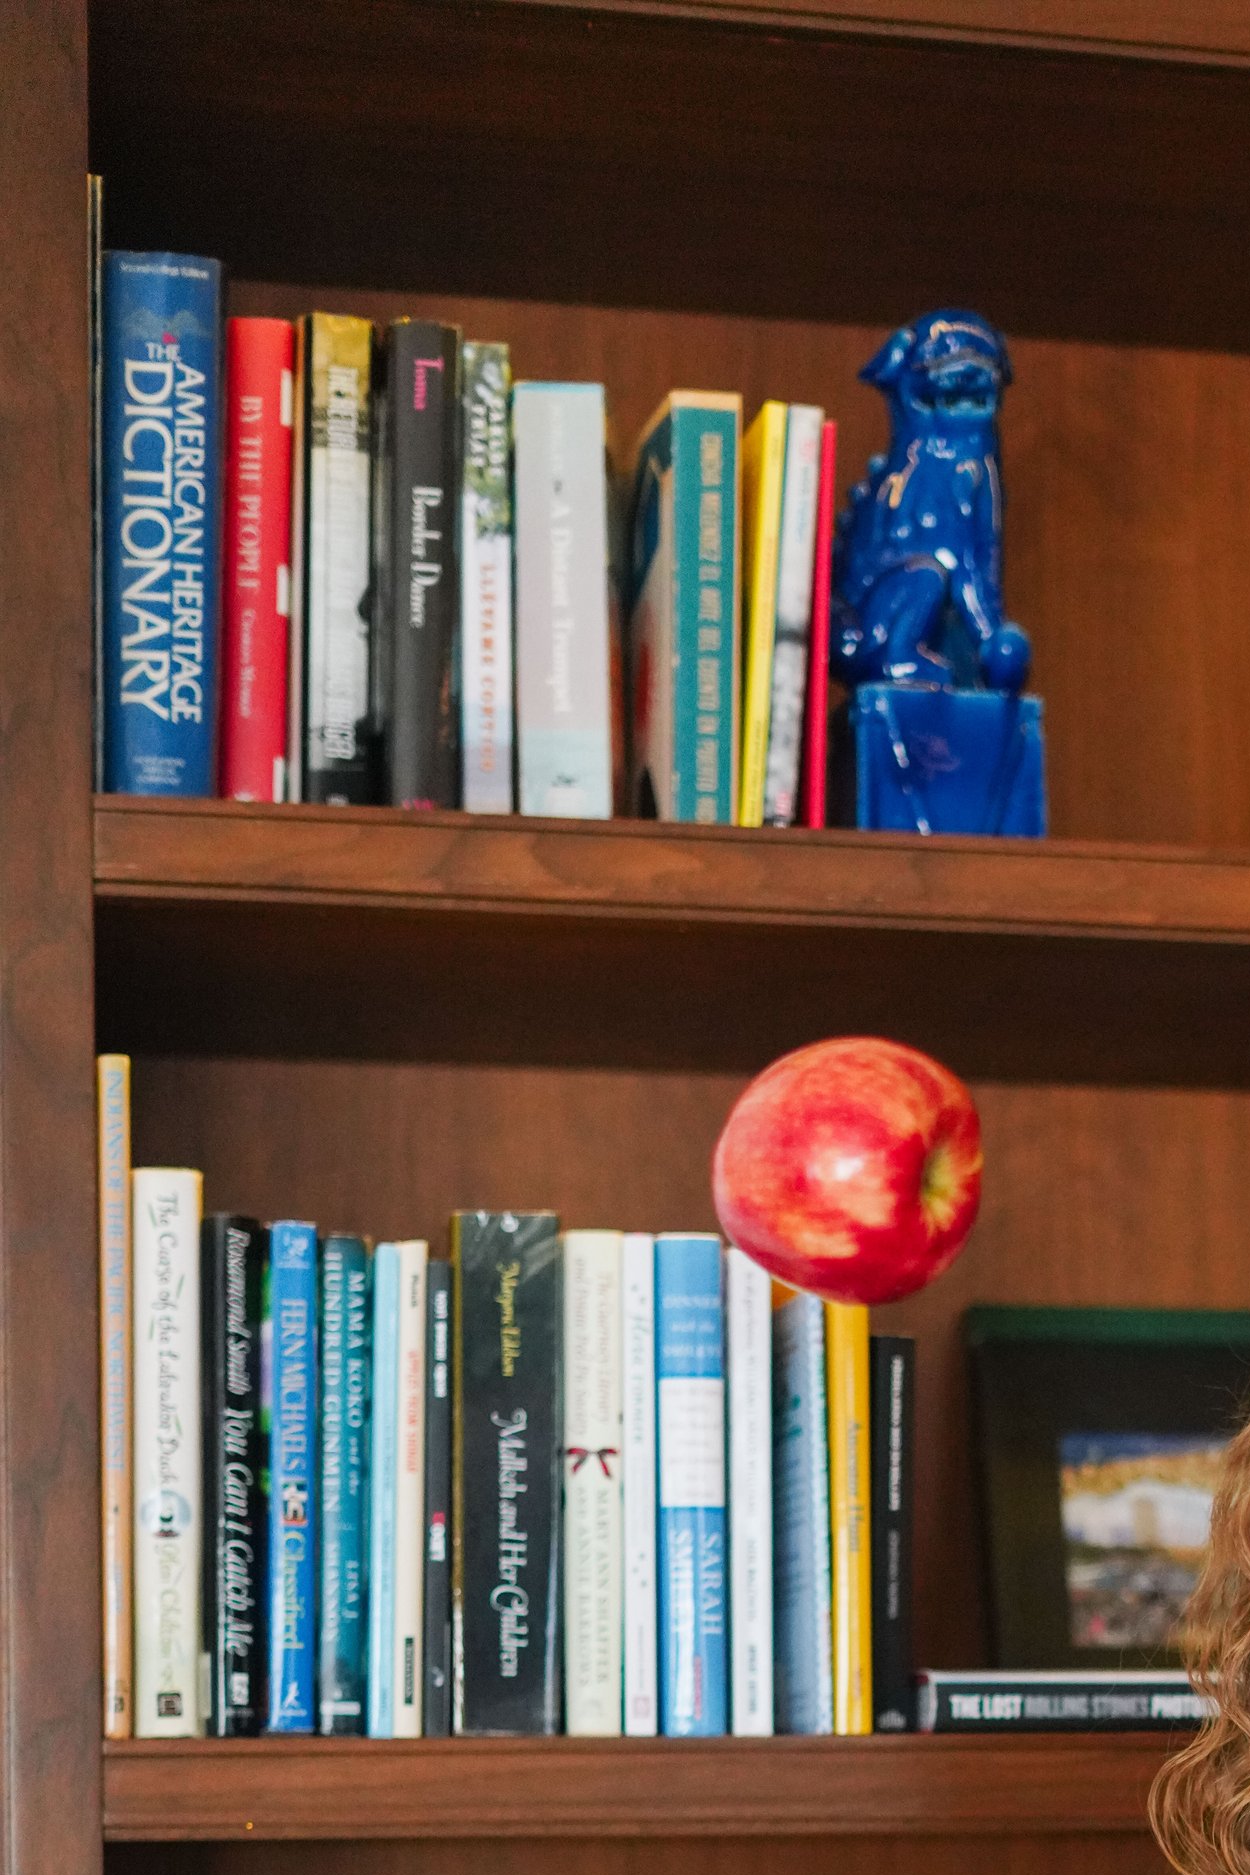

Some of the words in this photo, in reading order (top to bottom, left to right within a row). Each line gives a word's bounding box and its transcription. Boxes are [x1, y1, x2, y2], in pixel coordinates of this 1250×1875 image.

[145, 340, 181, 364] THE
[238, 396, 263, 425] BY
[172, 361, 205, 557] AMERICAN
[237, 434, 262, 488] THE
[120, 359, 173, 722] DICTIONARY
[410, 486, 445, 558] Border
[408, 560, 444, 629] Dance
[548, 527, 574, 608] Distant
[170, 560, 203, 725] HERITAGE
[542, 617, 575, 713] Trumpet
[104, 1208, 125, 1239] THE
[225, 1228, 253, 1338] Rosamond
[322, 1252, 343, 1387] HUNDRED
[347, 1271, 366, 1349] MAMA
[278, 1298, 308, 1359] FERN
[225, 1335, 252, 1397] Smith
[346, 1357, 364, 1429] KOKO
[223, 1406, 255, 1457] You
[278, 1361, 308, 1471] MICHAELS
[322, 1394, 343, 1512] GUNMEN
[499, 1500, 528, 1541] and
[222, 1538, 255, 1612] Catch
[498, 1542, 528, 1584] Her
[700, 1532, 724, 1636] SARAH
[223, 1614, 254, 1659] Me
[489, 1584, 530, 1679] Children
